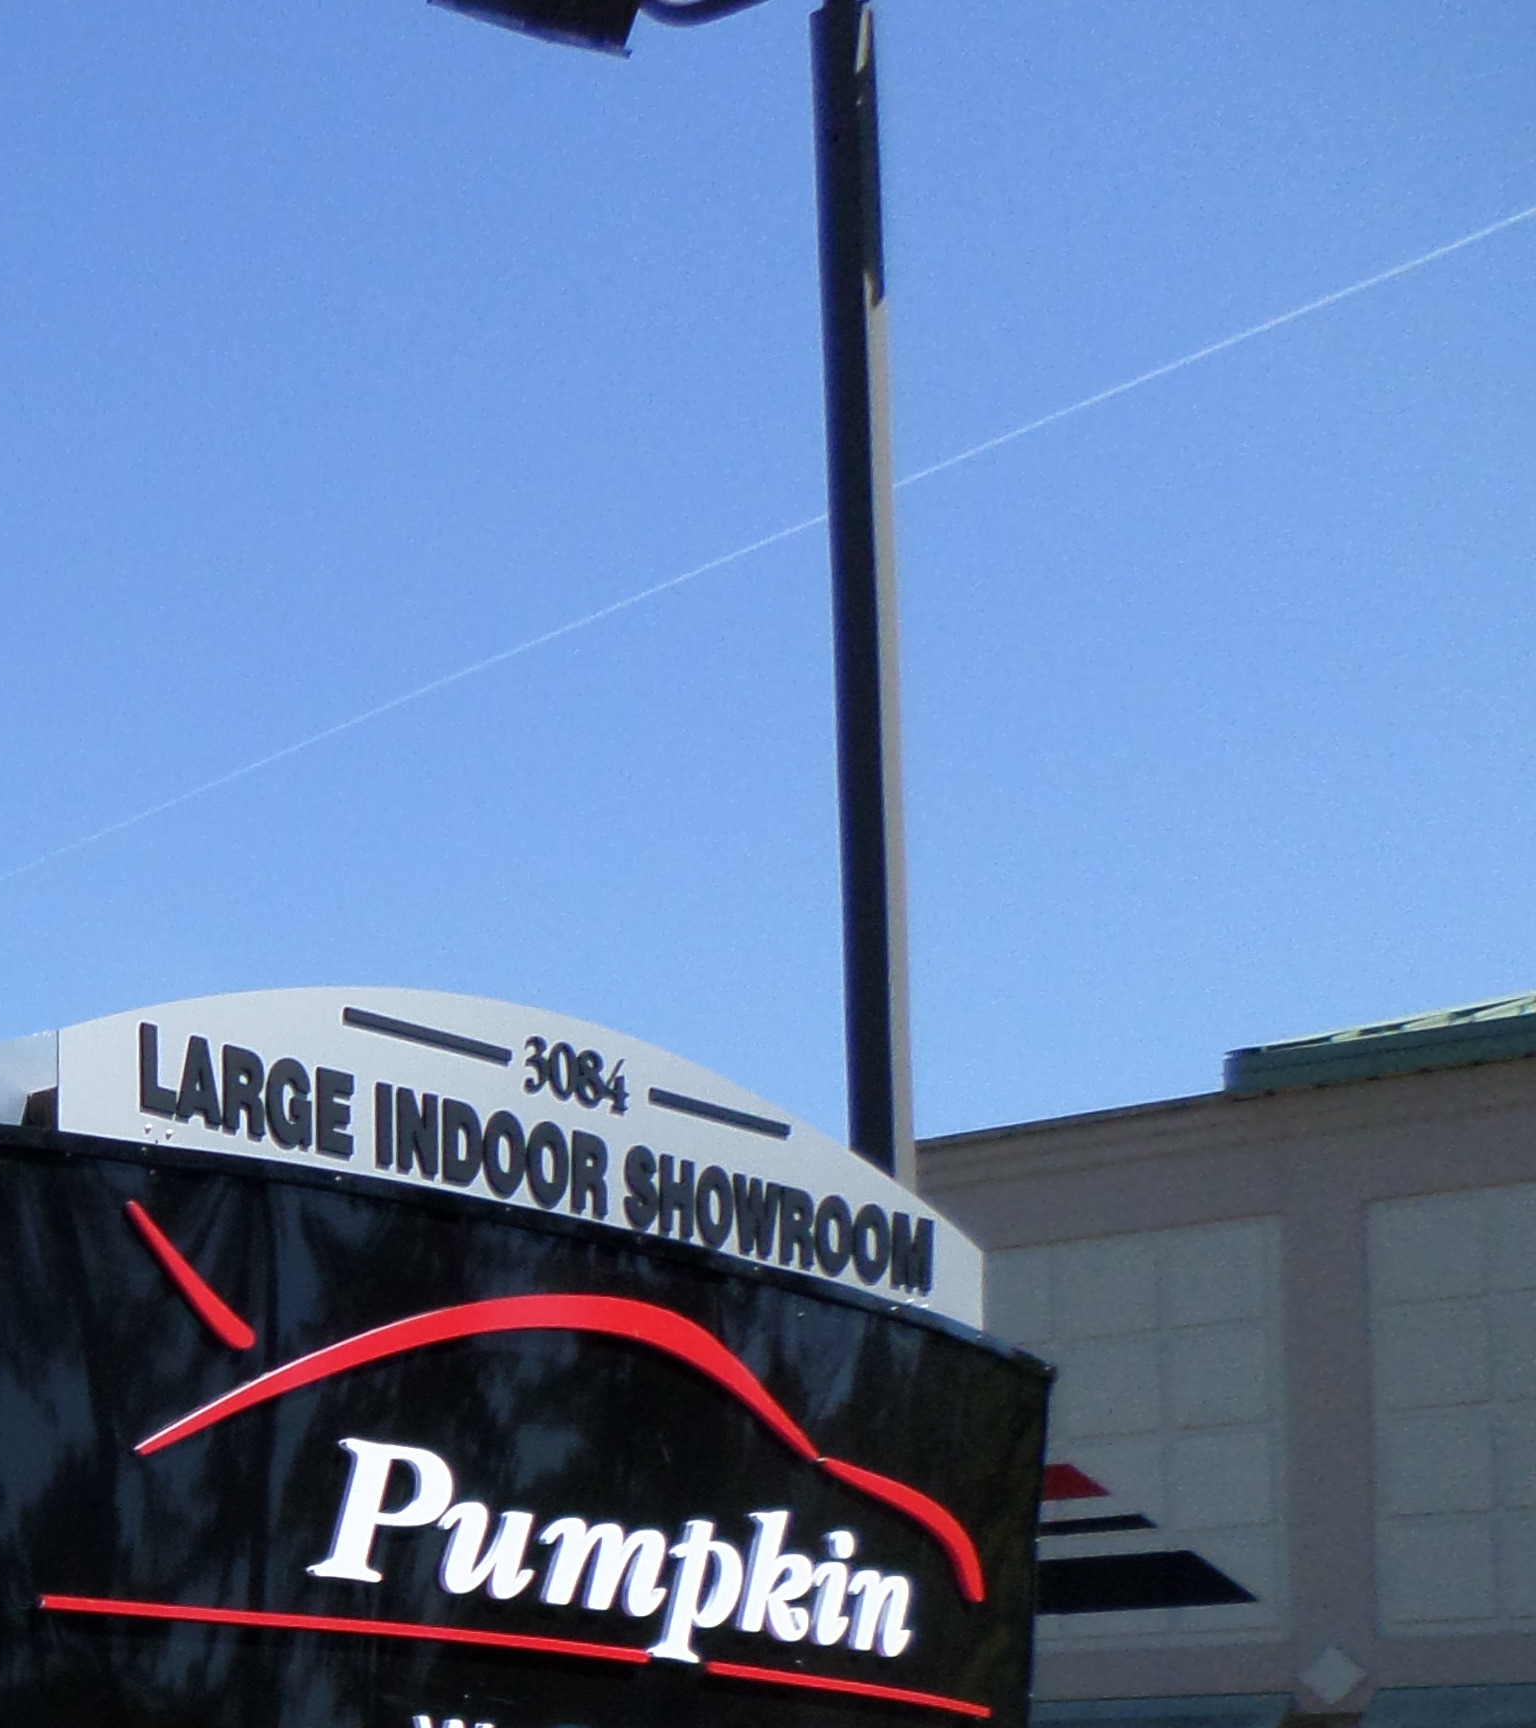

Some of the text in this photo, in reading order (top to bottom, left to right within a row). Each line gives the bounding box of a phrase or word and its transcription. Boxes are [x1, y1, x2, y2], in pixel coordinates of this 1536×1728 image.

[138, 1021, 936, 1297] LARGE INDOOR SHOWROOM
[523, 1035, 629, 1116] 3084
[306, 1437, 913, 1664] Pumpkin
